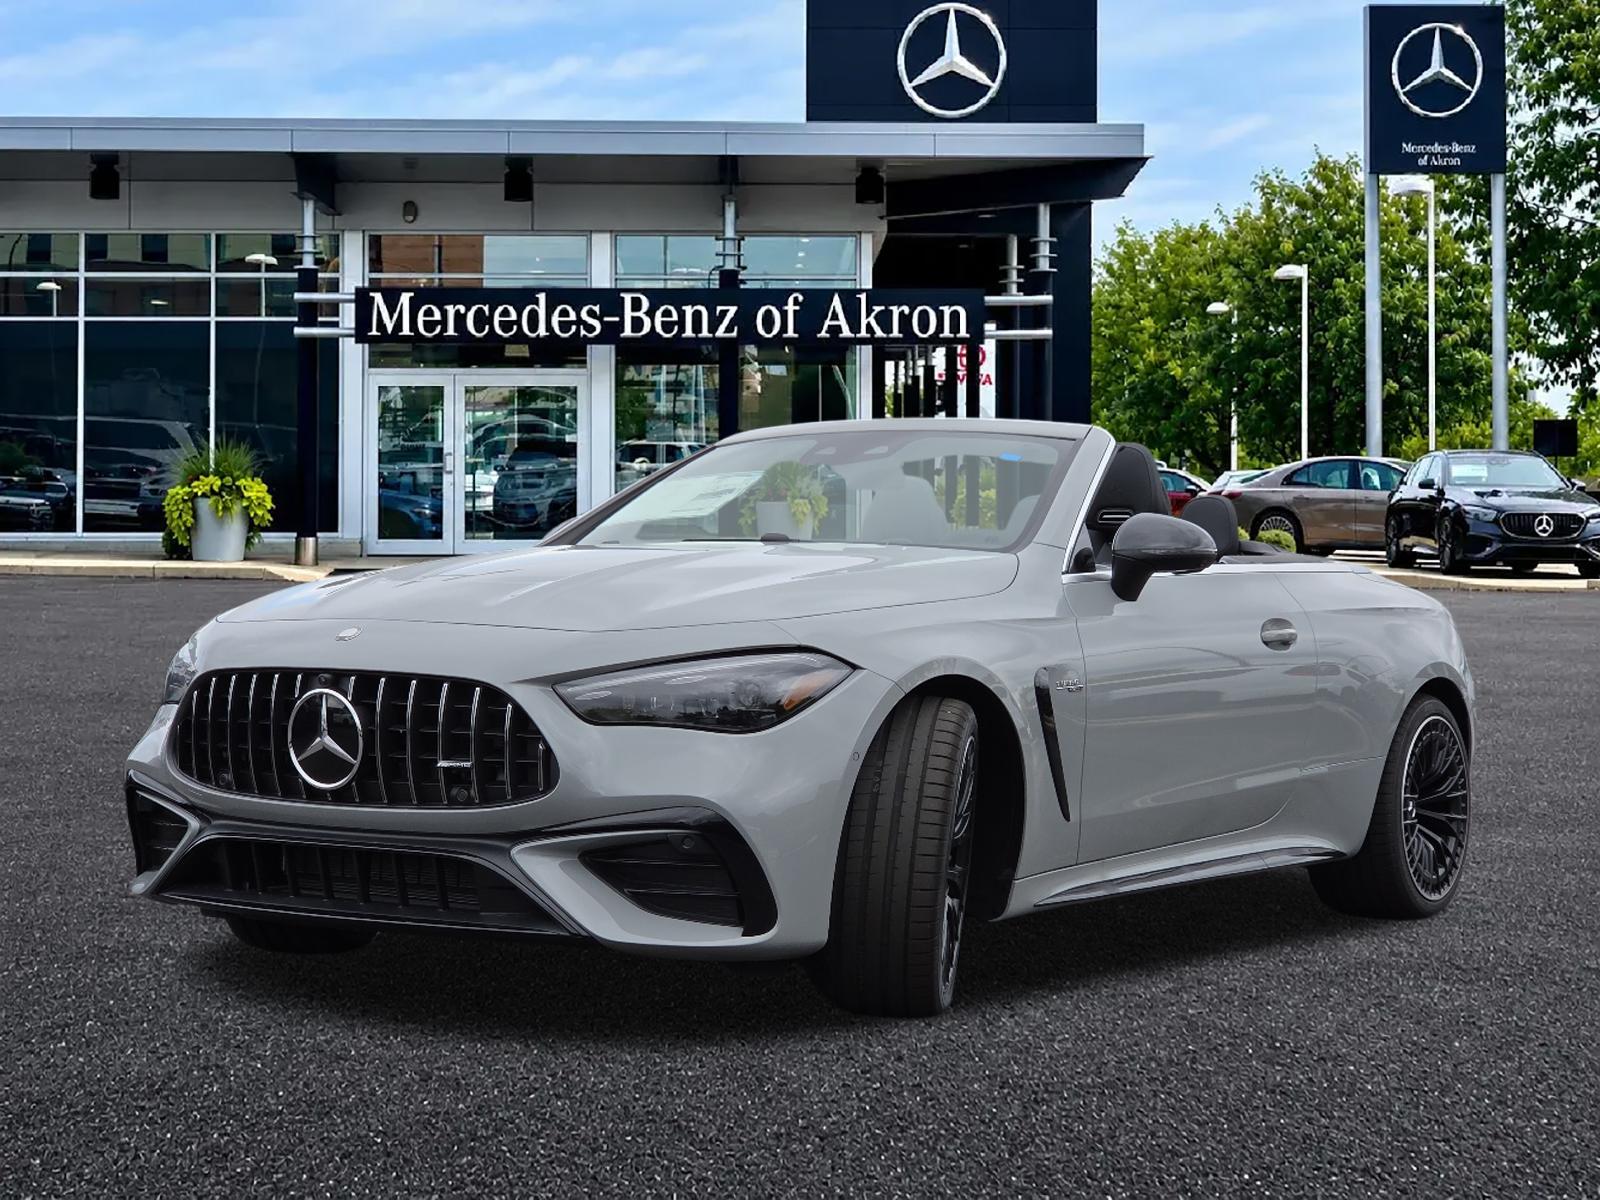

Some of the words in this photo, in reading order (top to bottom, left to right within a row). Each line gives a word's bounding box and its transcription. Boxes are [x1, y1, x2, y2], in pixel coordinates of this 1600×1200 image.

[1401, 141, 1477, 154] Mercedes-Benz
[1417, 154, 1429, 166] of
[1430, 154, 1461, 166] Akron
[367, 291, 738, 338] Mercedes-Benz
[755, 291, 804, 339] of
[817, 291, 971, 339] Akron
